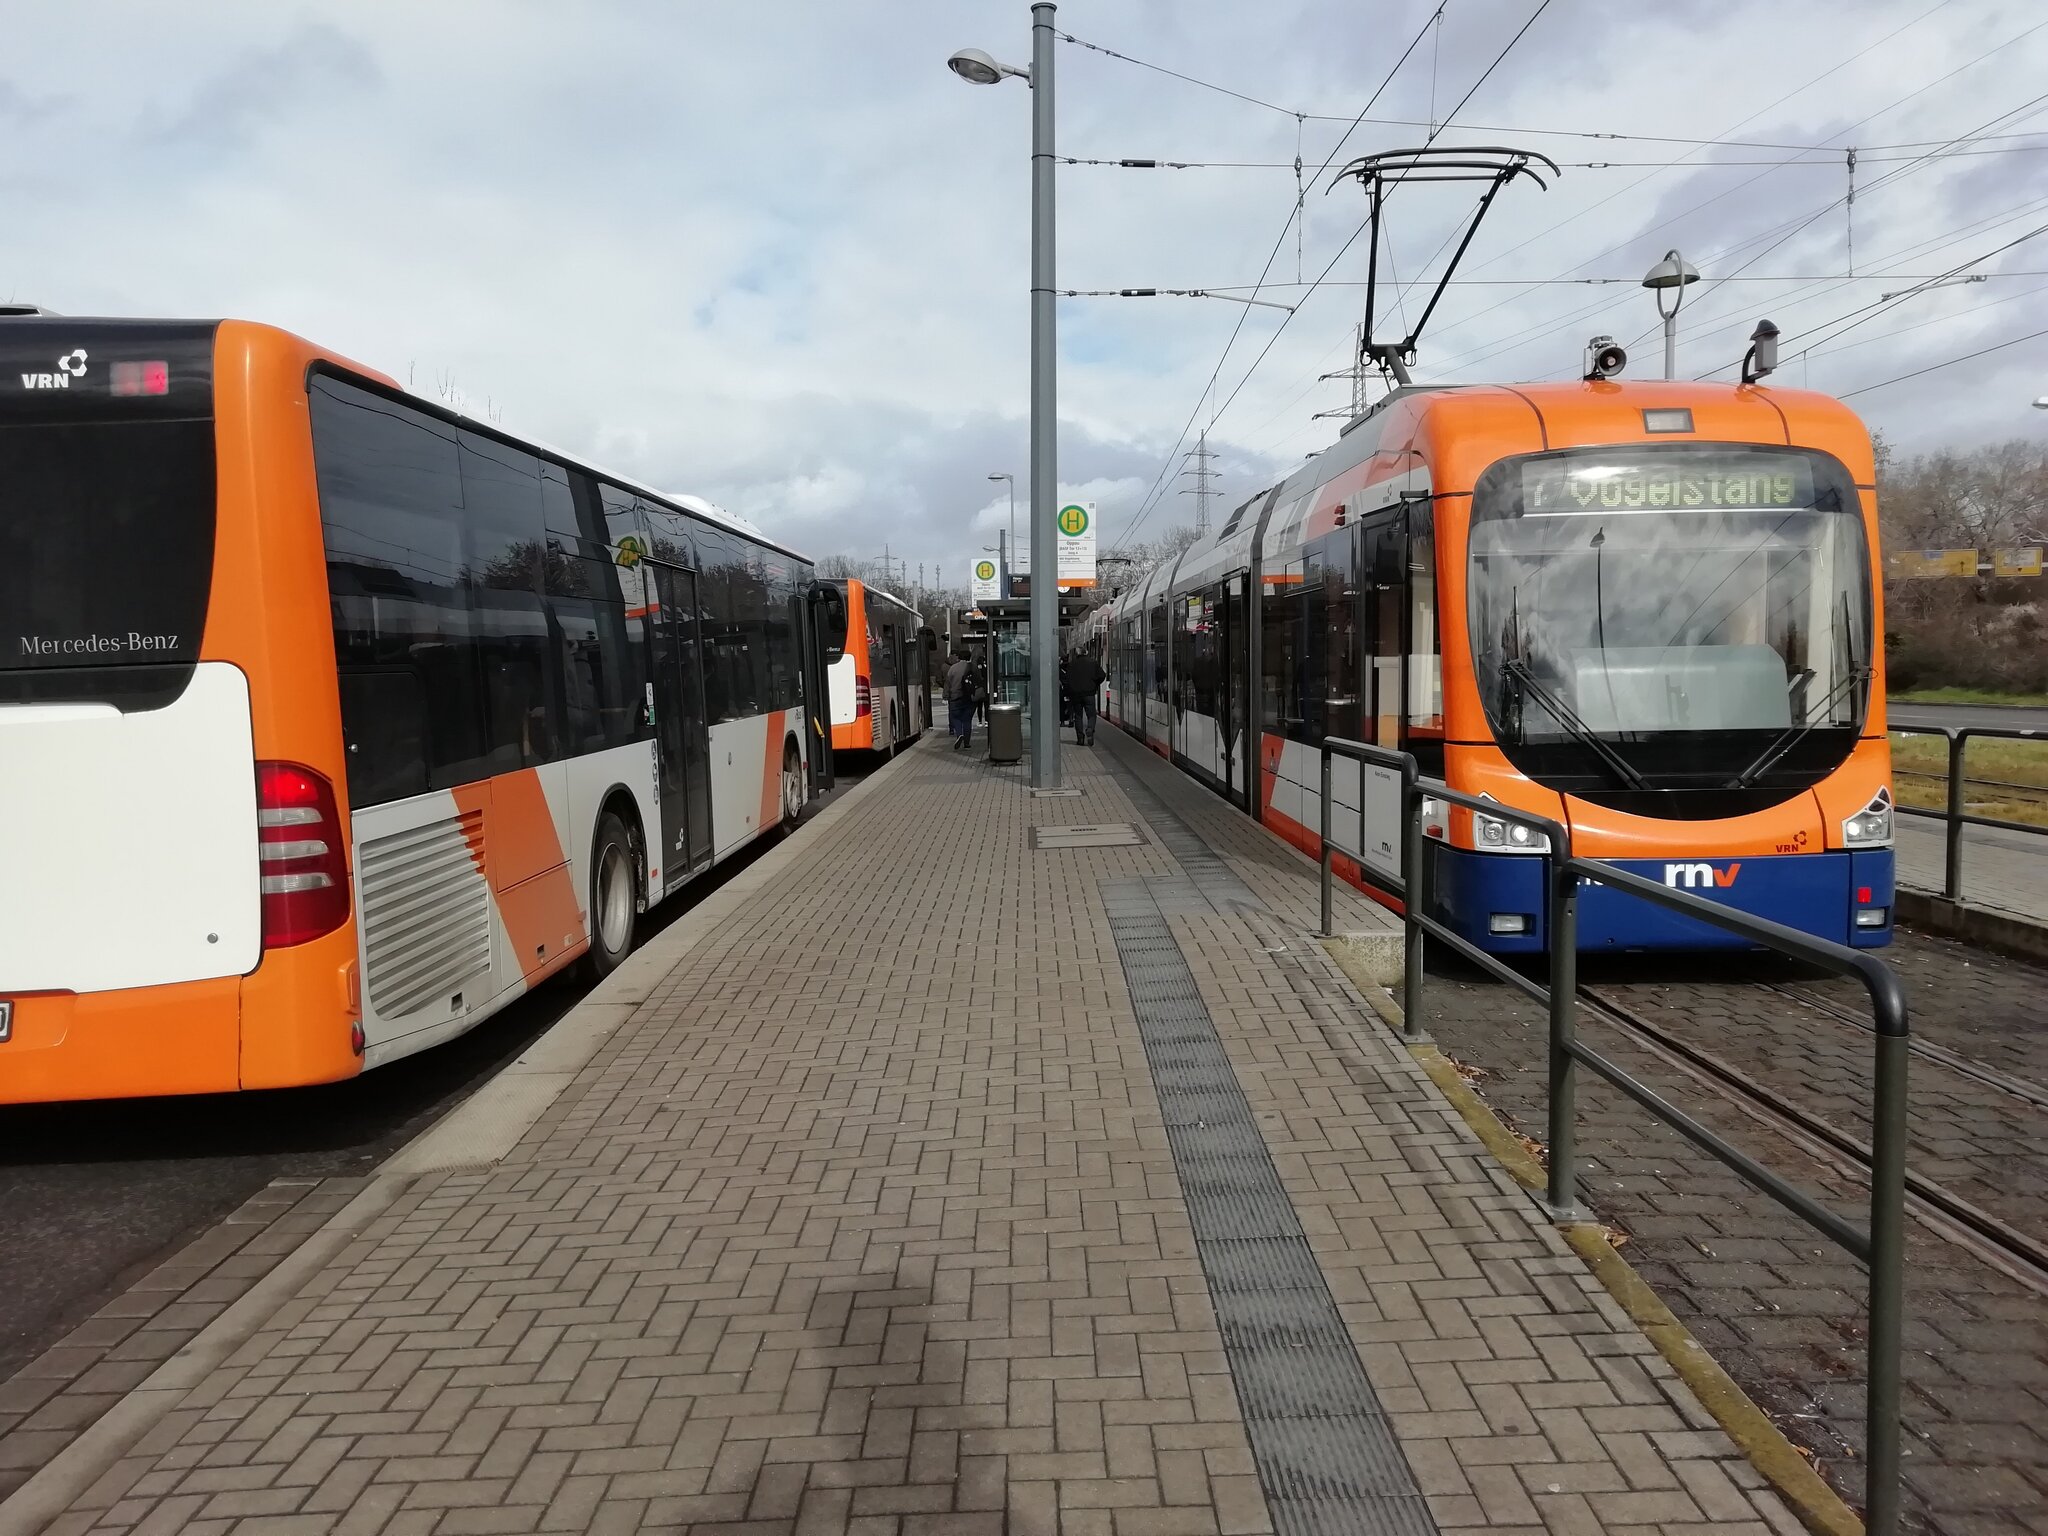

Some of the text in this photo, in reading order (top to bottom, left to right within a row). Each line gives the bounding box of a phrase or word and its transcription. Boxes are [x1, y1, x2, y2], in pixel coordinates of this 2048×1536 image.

[21, 373, 69, 389] VRN
[1568, 472, 1797, 508] Vogelstang
[1066, 511, 1080, 530] H
[20, 632, 179, 656] Mercedes-Benz
[1776, 844, 1799, 853] VRN
[1665, 863, 1742, 888] rnv
